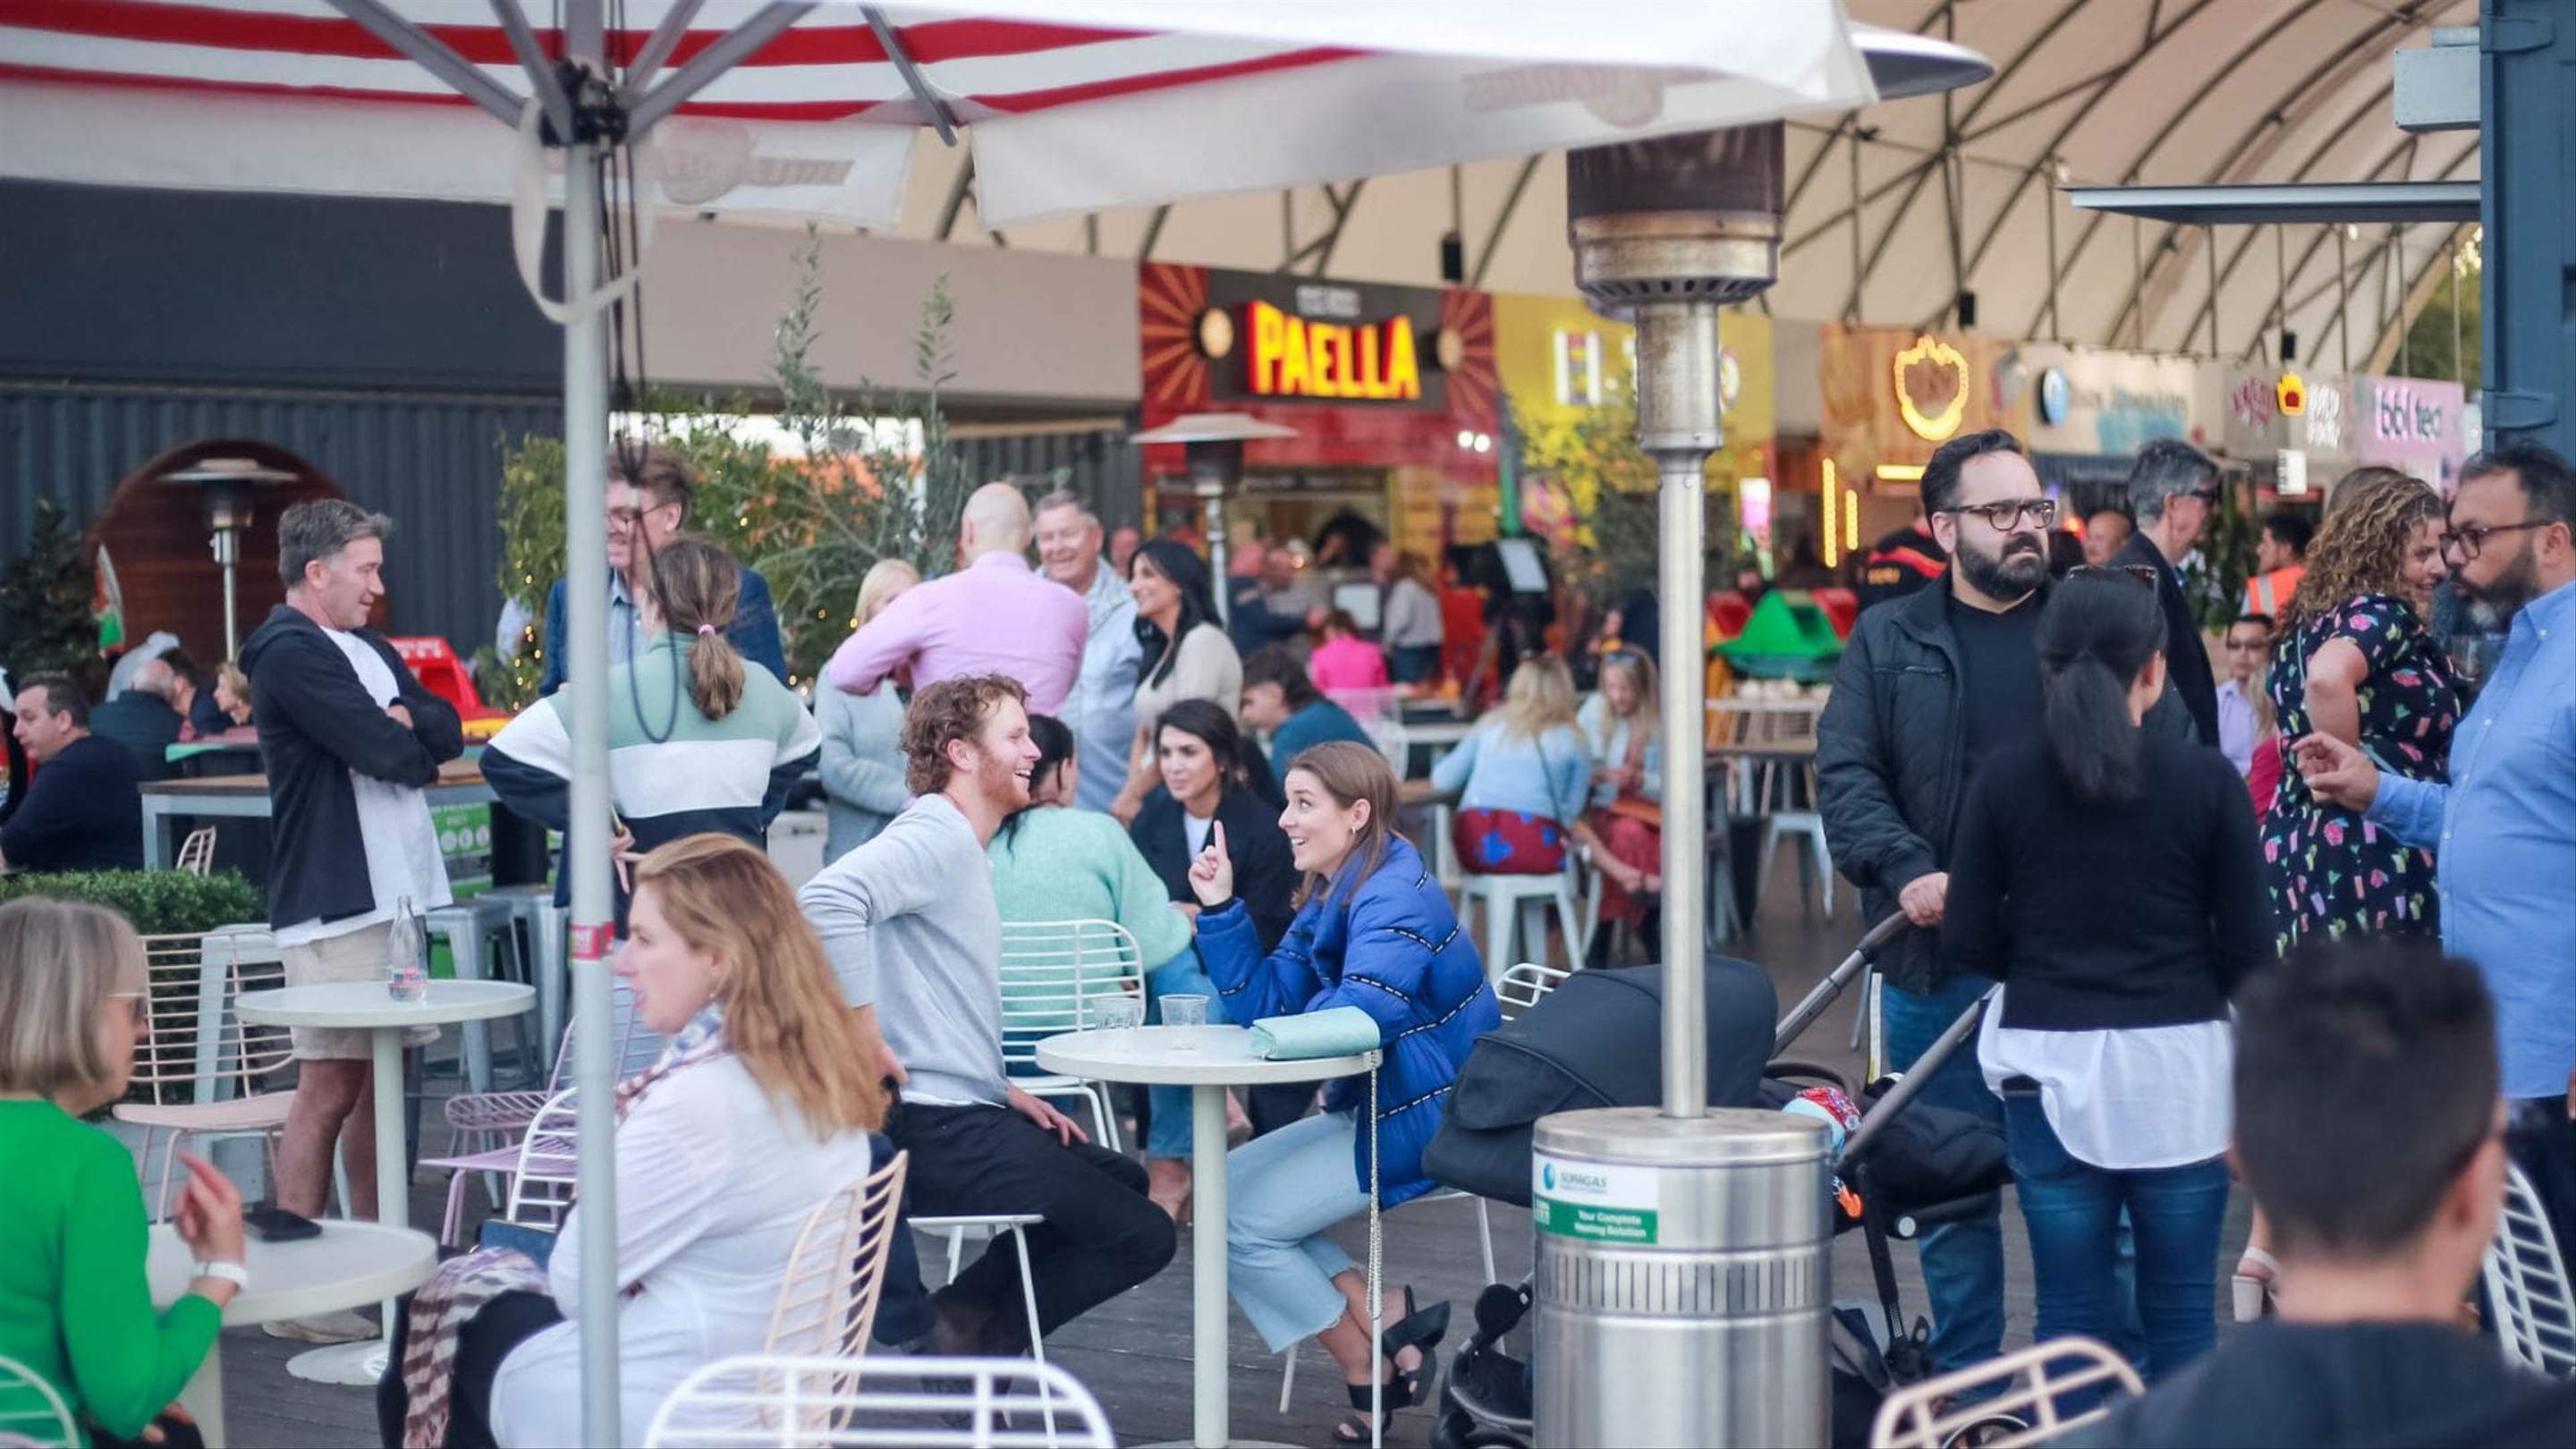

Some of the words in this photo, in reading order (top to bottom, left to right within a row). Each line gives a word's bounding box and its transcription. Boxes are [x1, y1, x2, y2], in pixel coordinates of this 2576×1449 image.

[1249, 299, 1420, 400] PAELLA
[1597, 1211, 1642, 1226] Complete
[1606, 1224, 1647, 1238] Solution
